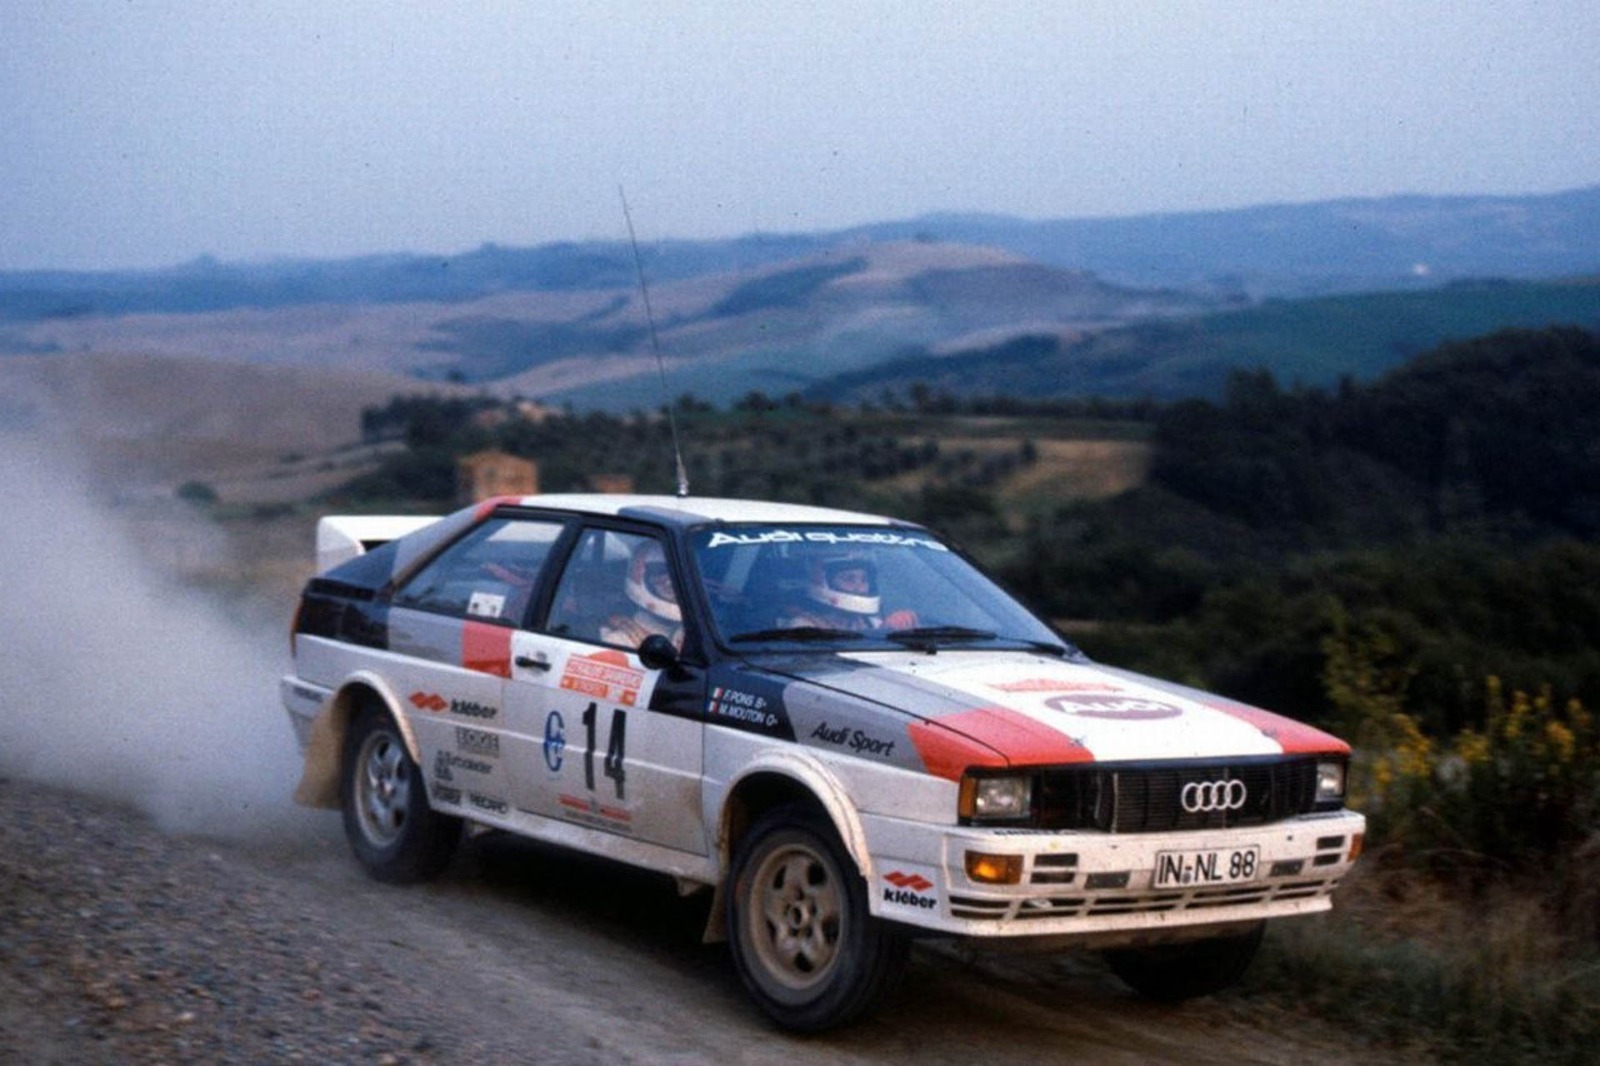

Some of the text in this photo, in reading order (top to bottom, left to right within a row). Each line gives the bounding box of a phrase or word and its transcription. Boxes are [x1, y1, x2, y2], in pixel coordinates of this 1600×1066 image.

[708, 530, 803, 548] Audi
[582, 701, 627, 801] 14
[811, 722, 895, 756] Audi Sport
[1229, 851, 1255, 879] 88
